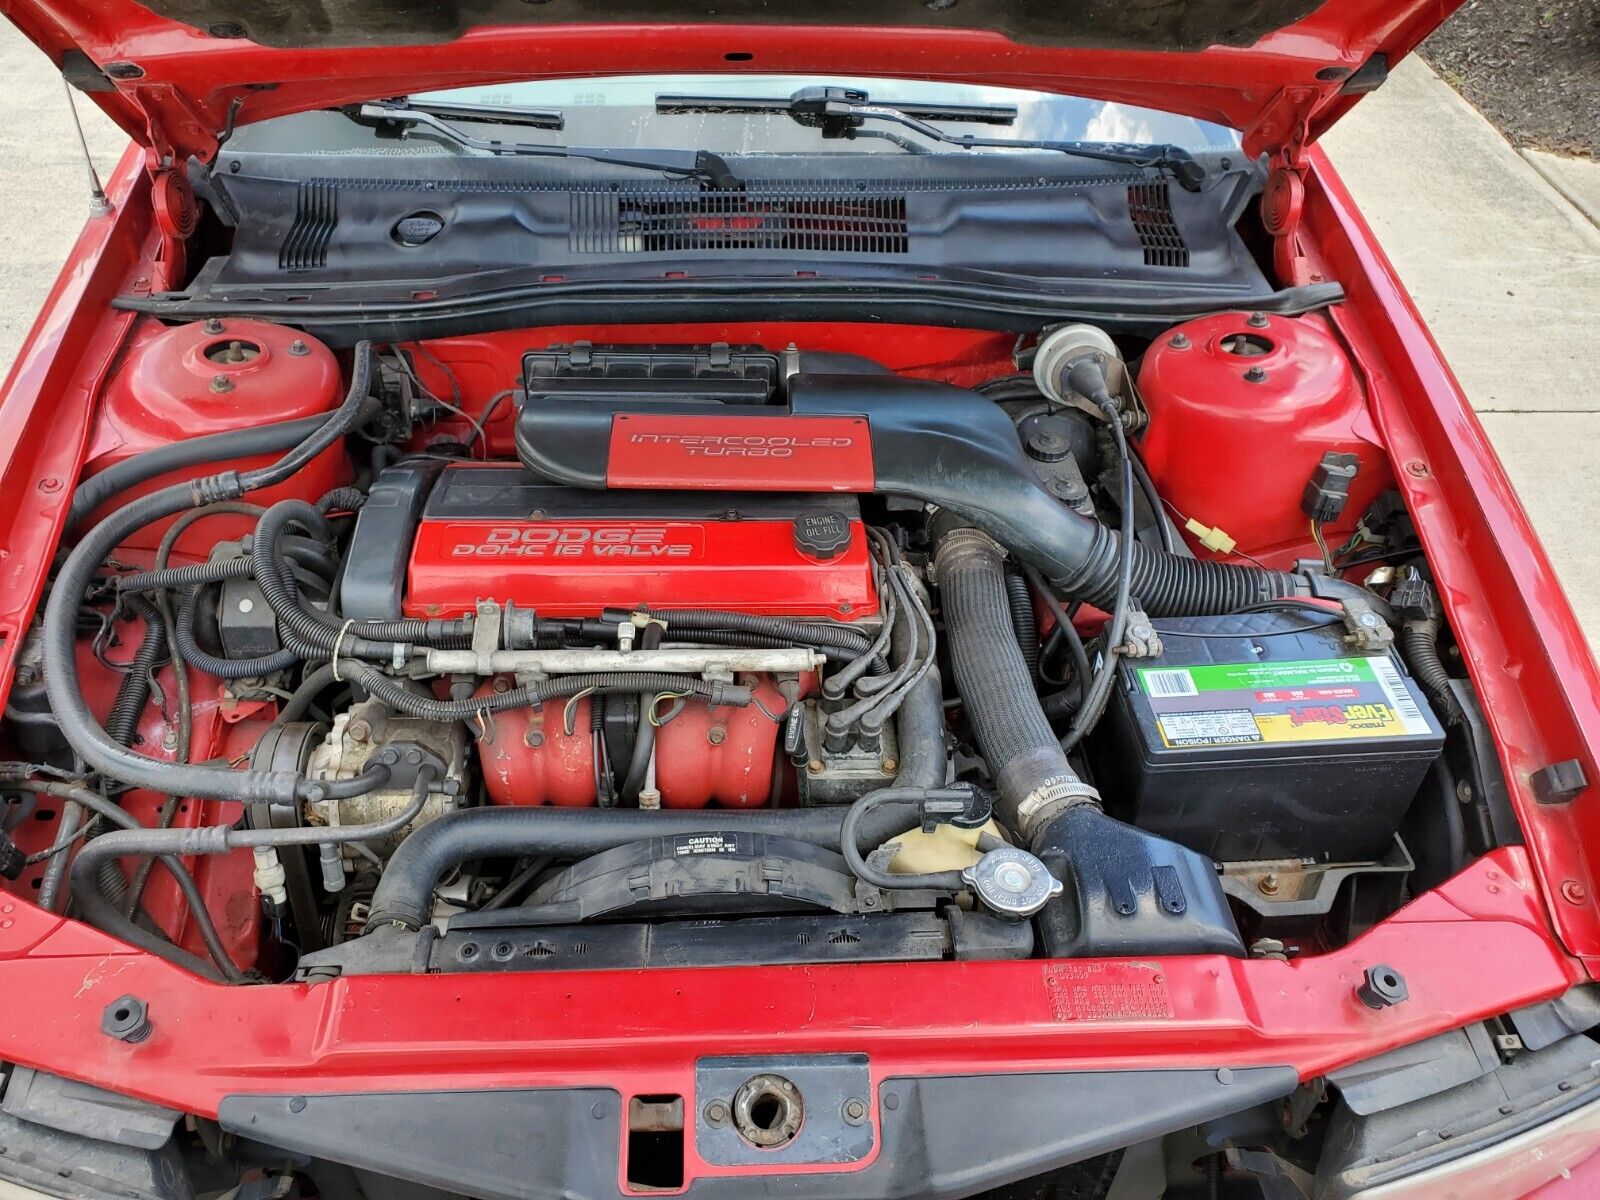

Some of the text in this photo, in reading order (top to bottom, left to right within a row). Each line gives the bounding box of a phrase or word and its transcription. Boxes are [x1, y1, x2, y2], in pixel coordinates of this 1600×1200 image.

[630, 434, 852, 447] INTERCOOLED
[685, 446, 793, 457] TURBO
[805, 515, 837, 527] ENGINE
[487, 528, 667, 544] DODGE
[806, 525, 842, 537] OIL FILL
[452, 544, 694, 557] DOHC 16 VALVE
[788, 717, 798, 739] ENGINE
[1176, 737, 1209, 745] POISON
[1212, 735, 1256, 743] DANGER
